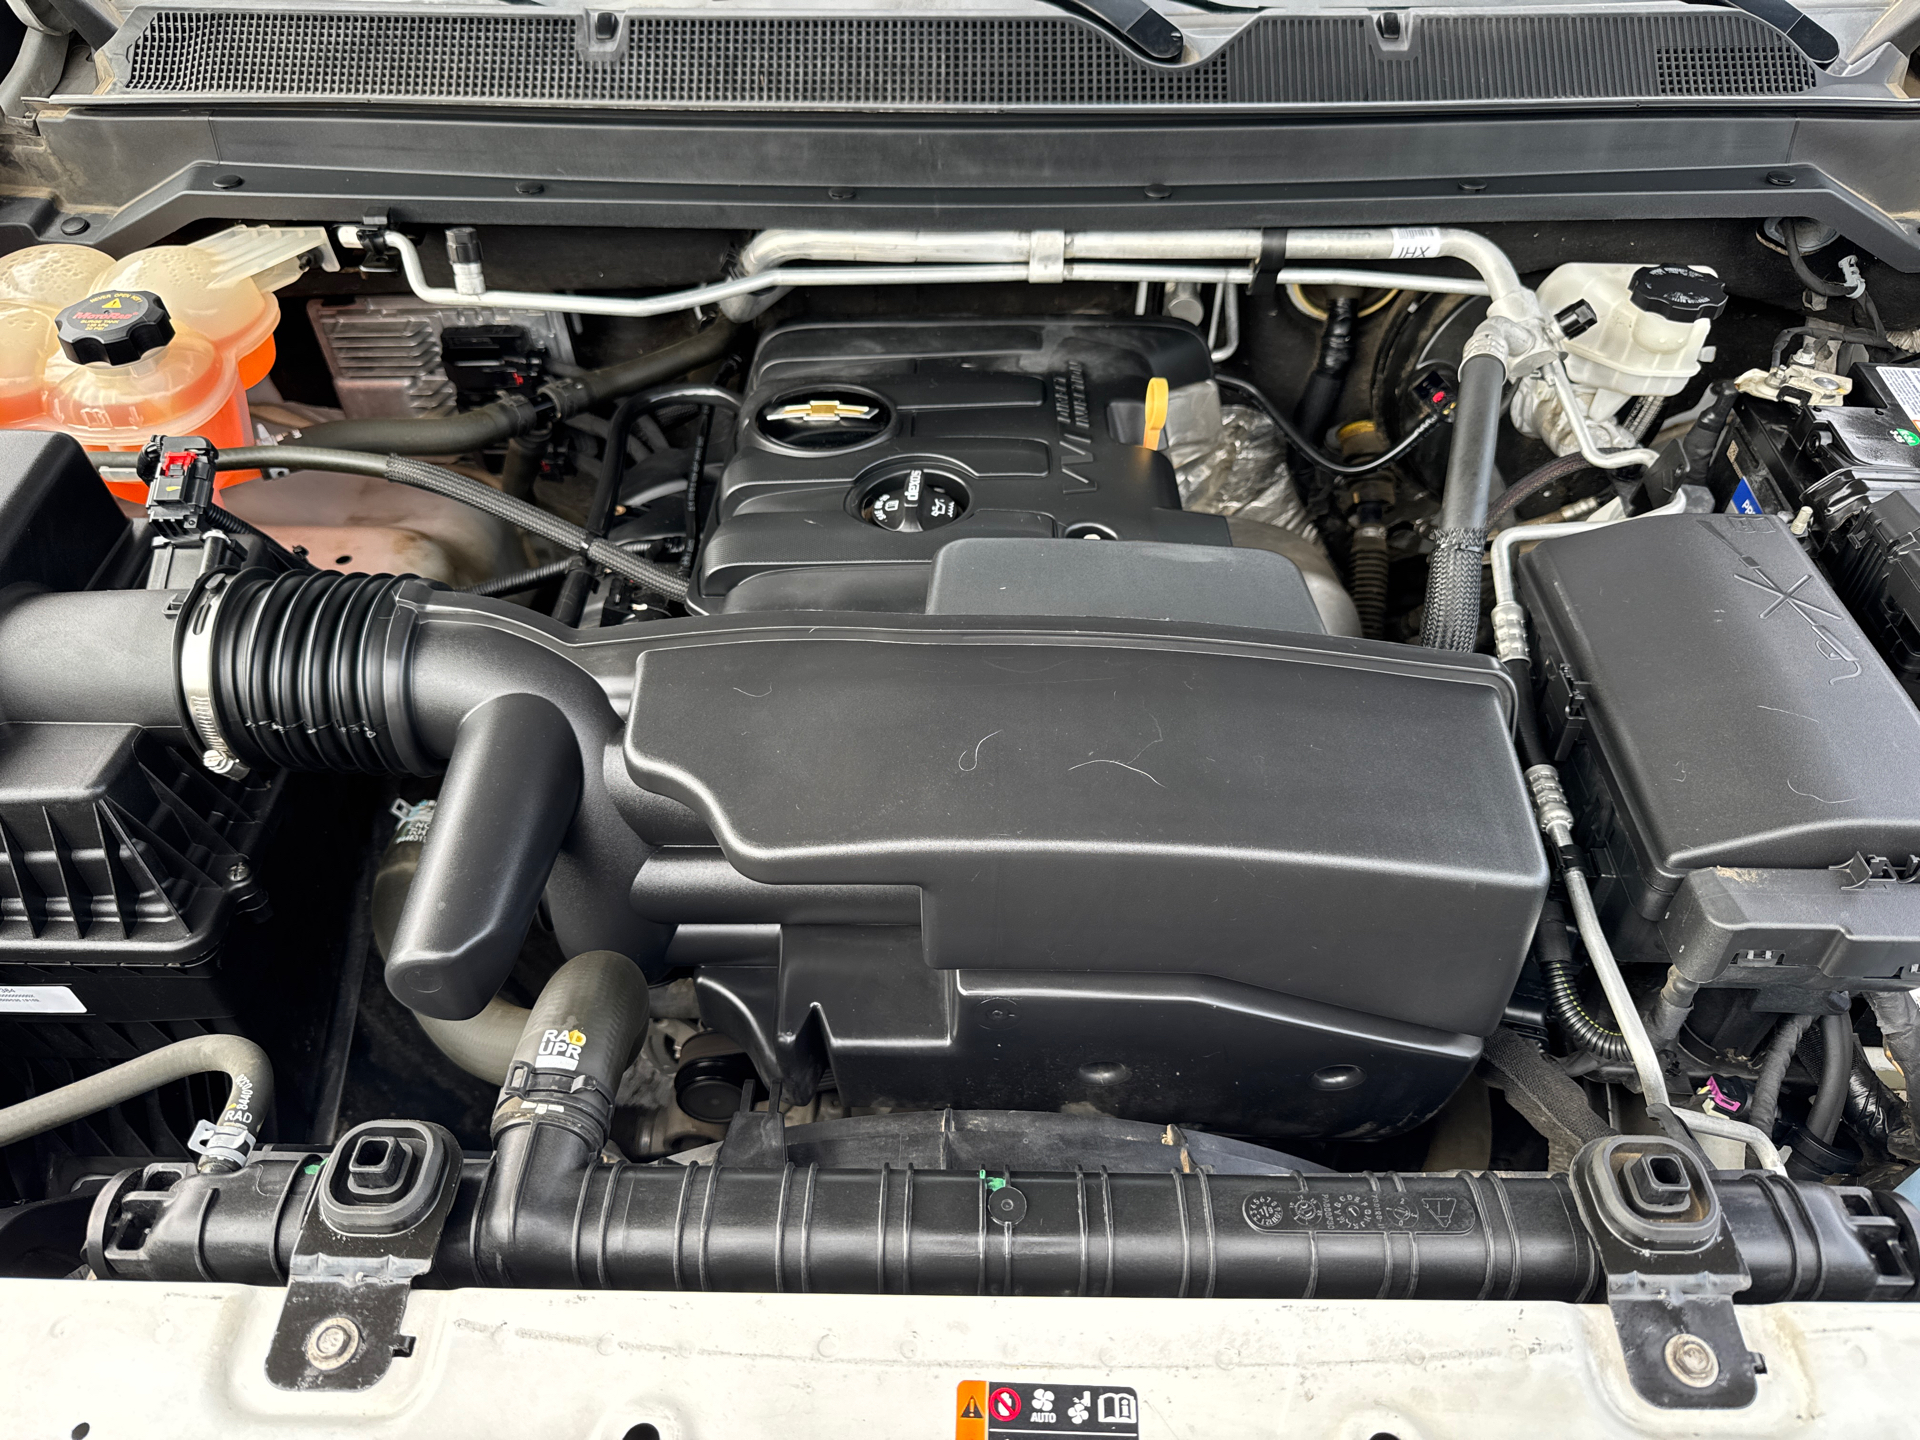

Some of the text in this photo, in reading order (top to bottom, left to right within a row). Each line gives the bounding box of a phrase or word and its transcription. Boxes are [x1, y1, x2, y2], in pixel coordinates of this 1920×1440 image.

[89, 294, 111, 303] NEVER
[904, 470, 922, 501] dexos
[541, 1029, 587, 1047] RAD
[538, 1041, 582, 1060] UPR
[225, 1110, 253, 1123] RAD
[1030, 1412, 1057, 1423] AUTO
